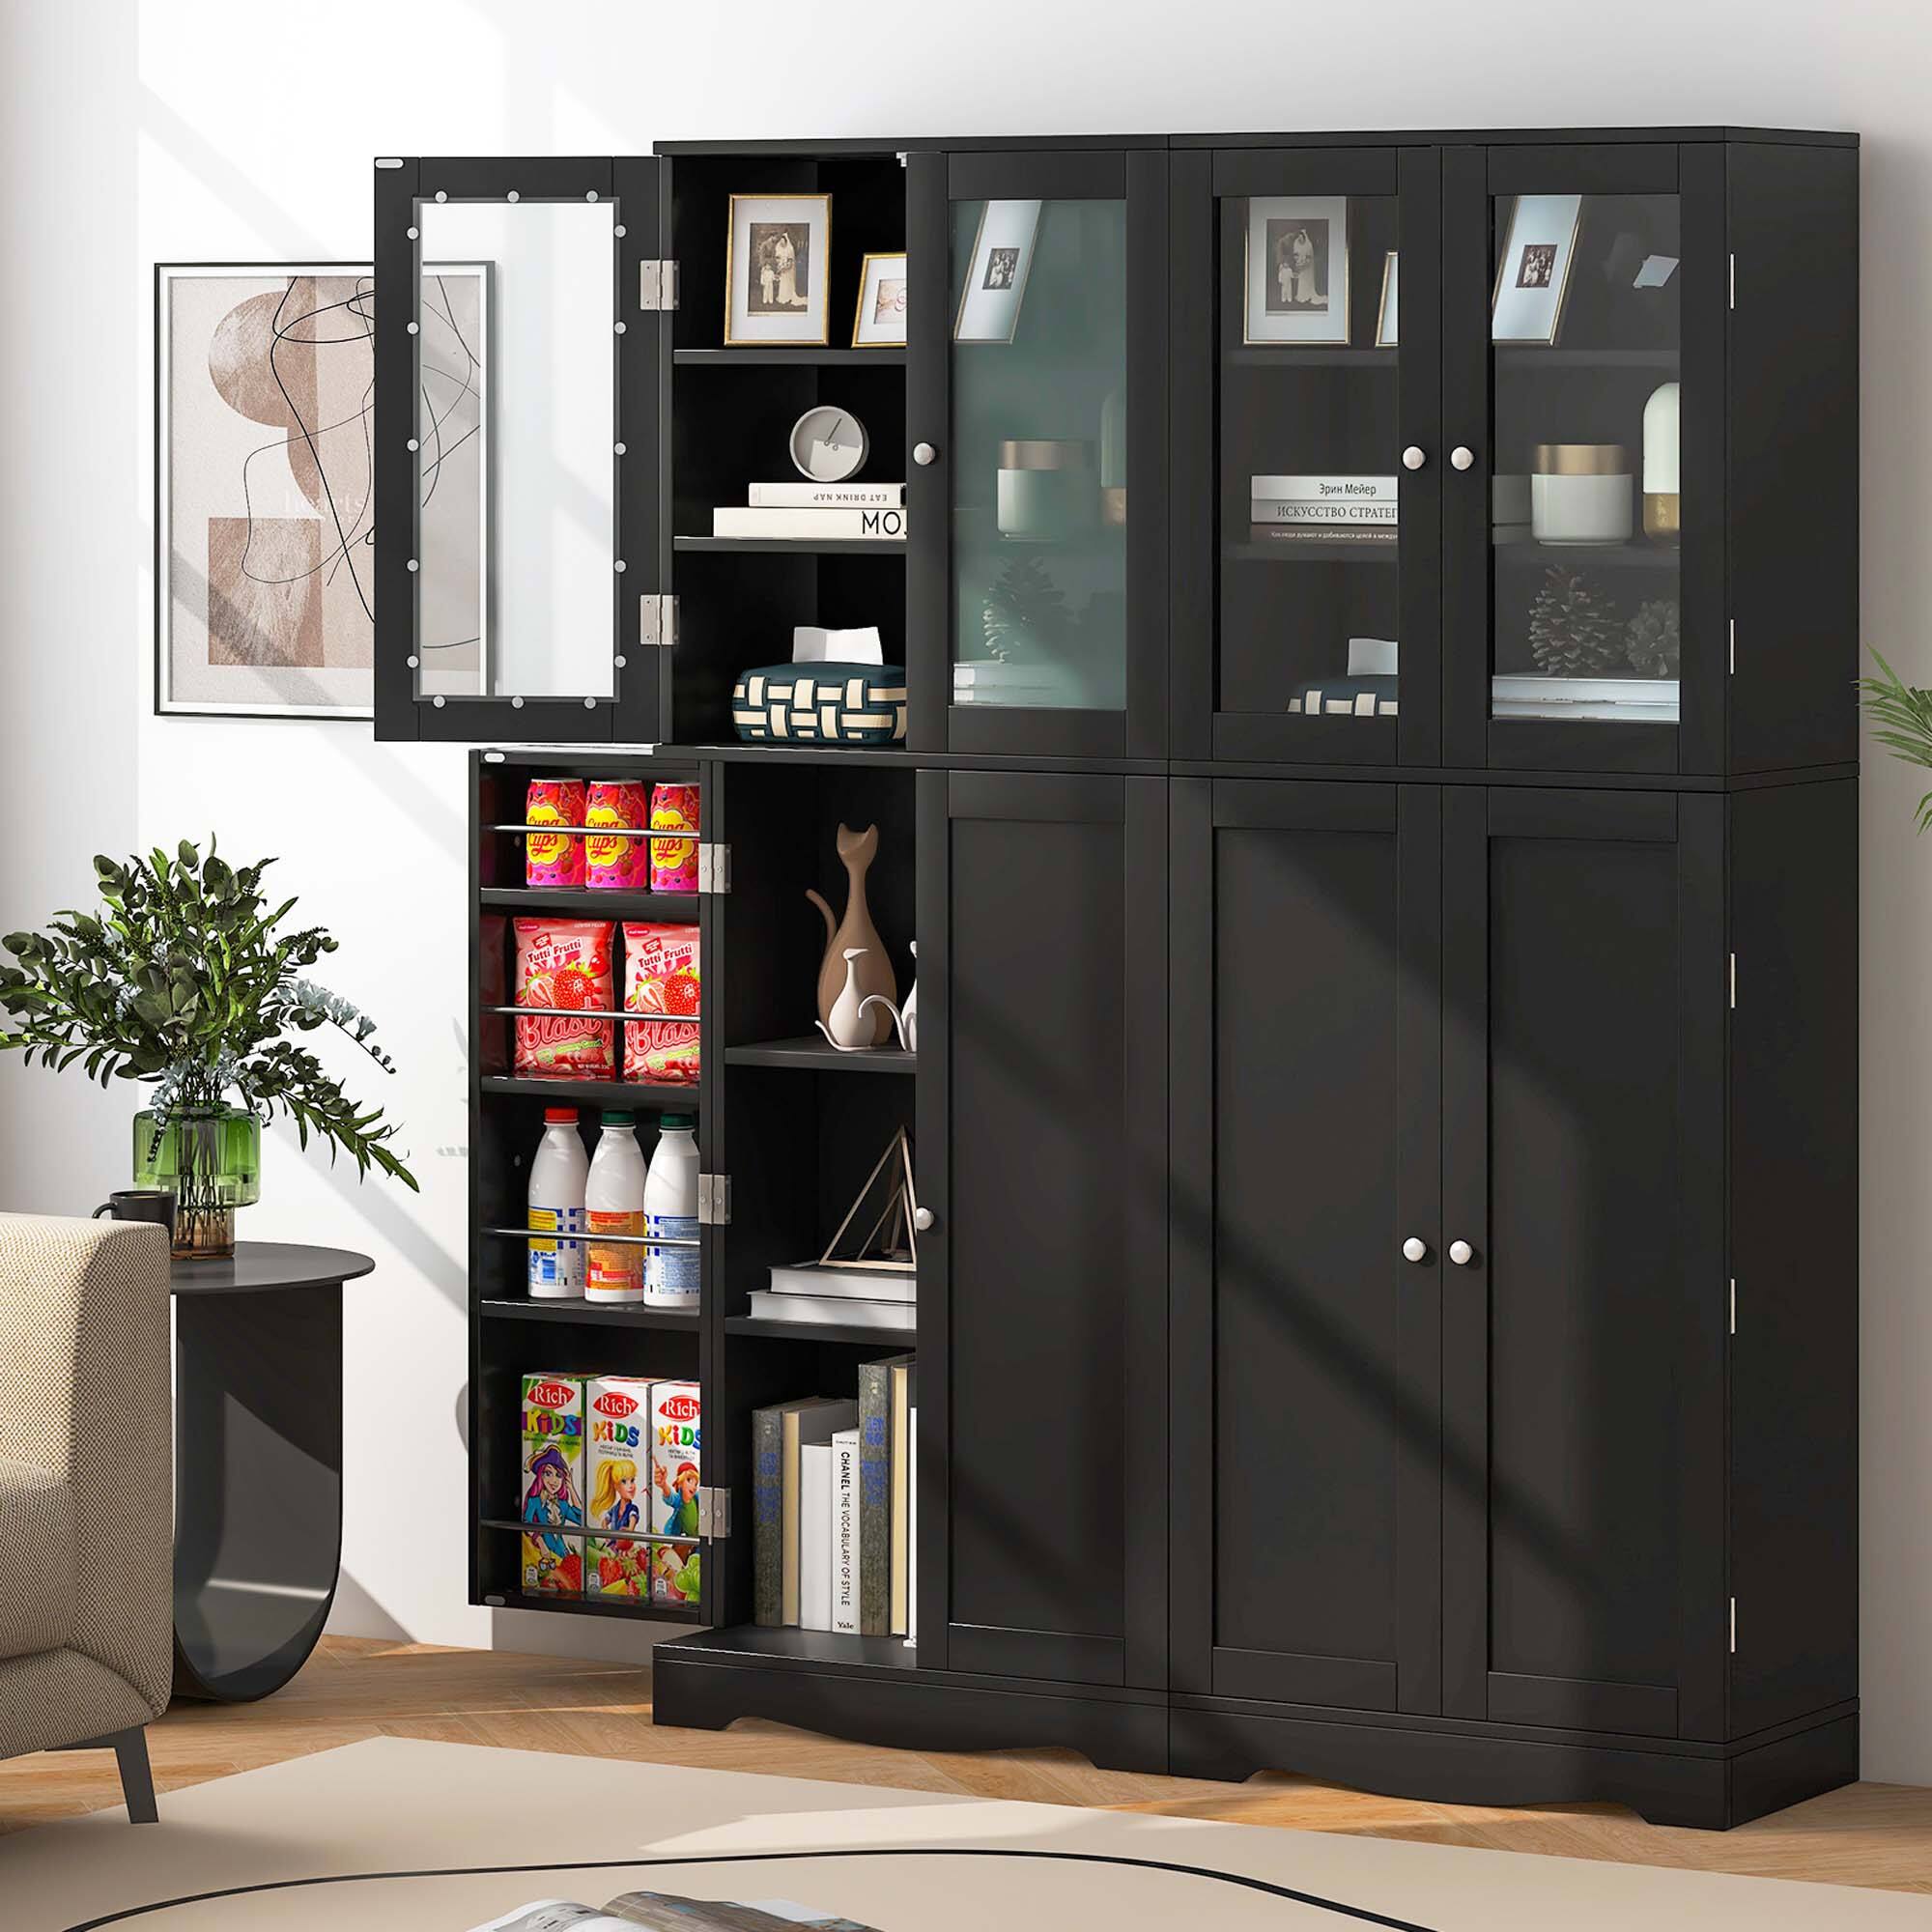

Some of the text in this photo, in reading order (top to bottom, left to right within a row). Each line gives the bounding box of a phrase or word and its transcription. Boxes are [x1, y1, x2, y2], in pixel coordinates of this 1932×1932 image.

[1320, 483, 1377, 497] Эрин Мейер
[1277, 505, 1347, 518] ИСКУССТВО
[862, 511, 907, 535] MO
[526, 947, 551, 963] Tutti
[553, 938, 582, 955] Frutti
[638, 952, 662, 968] Tutti
[664, 943, 693, 959] Frutti
[534, 1385, 568, 1406] Rich
[600, 1395, 633, 1415] Rich
[666, 1400, 698, 1418] Rich
[840, 1451, 851, 1605] CHANEL THE VOCABULARY OF STYLE
[837, 1621, 854, 1630] Yale
